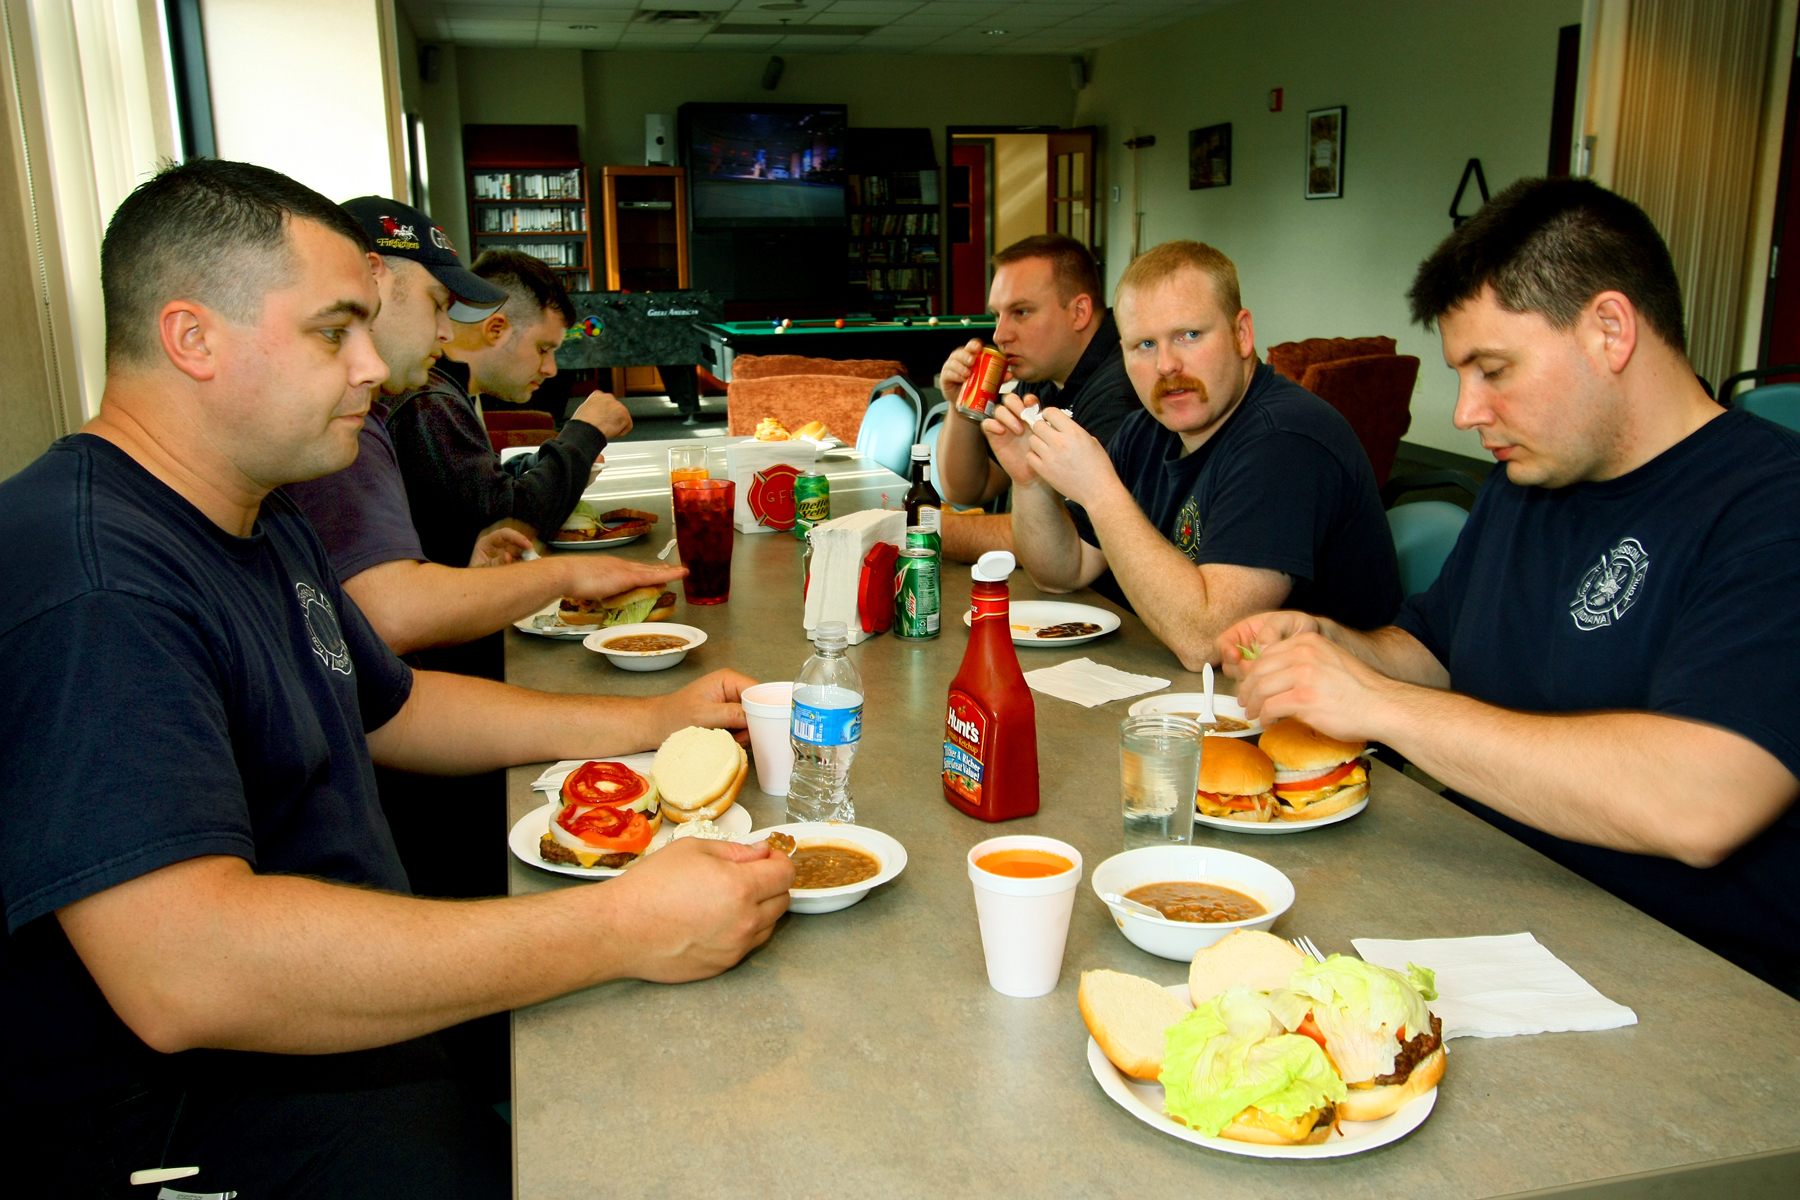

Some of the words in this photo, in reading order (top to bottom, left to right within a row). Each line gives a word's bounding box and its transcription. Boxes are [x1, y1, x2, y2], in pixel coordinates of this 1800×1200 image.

[377, 238, 420, 249] Firefighters
[947, 706, 980, 744] Hunt's
[958, 736, 979, 756] Ketchup
[962, 753, 981, 773] Richer
[962, 763, 980, 782] Value!
